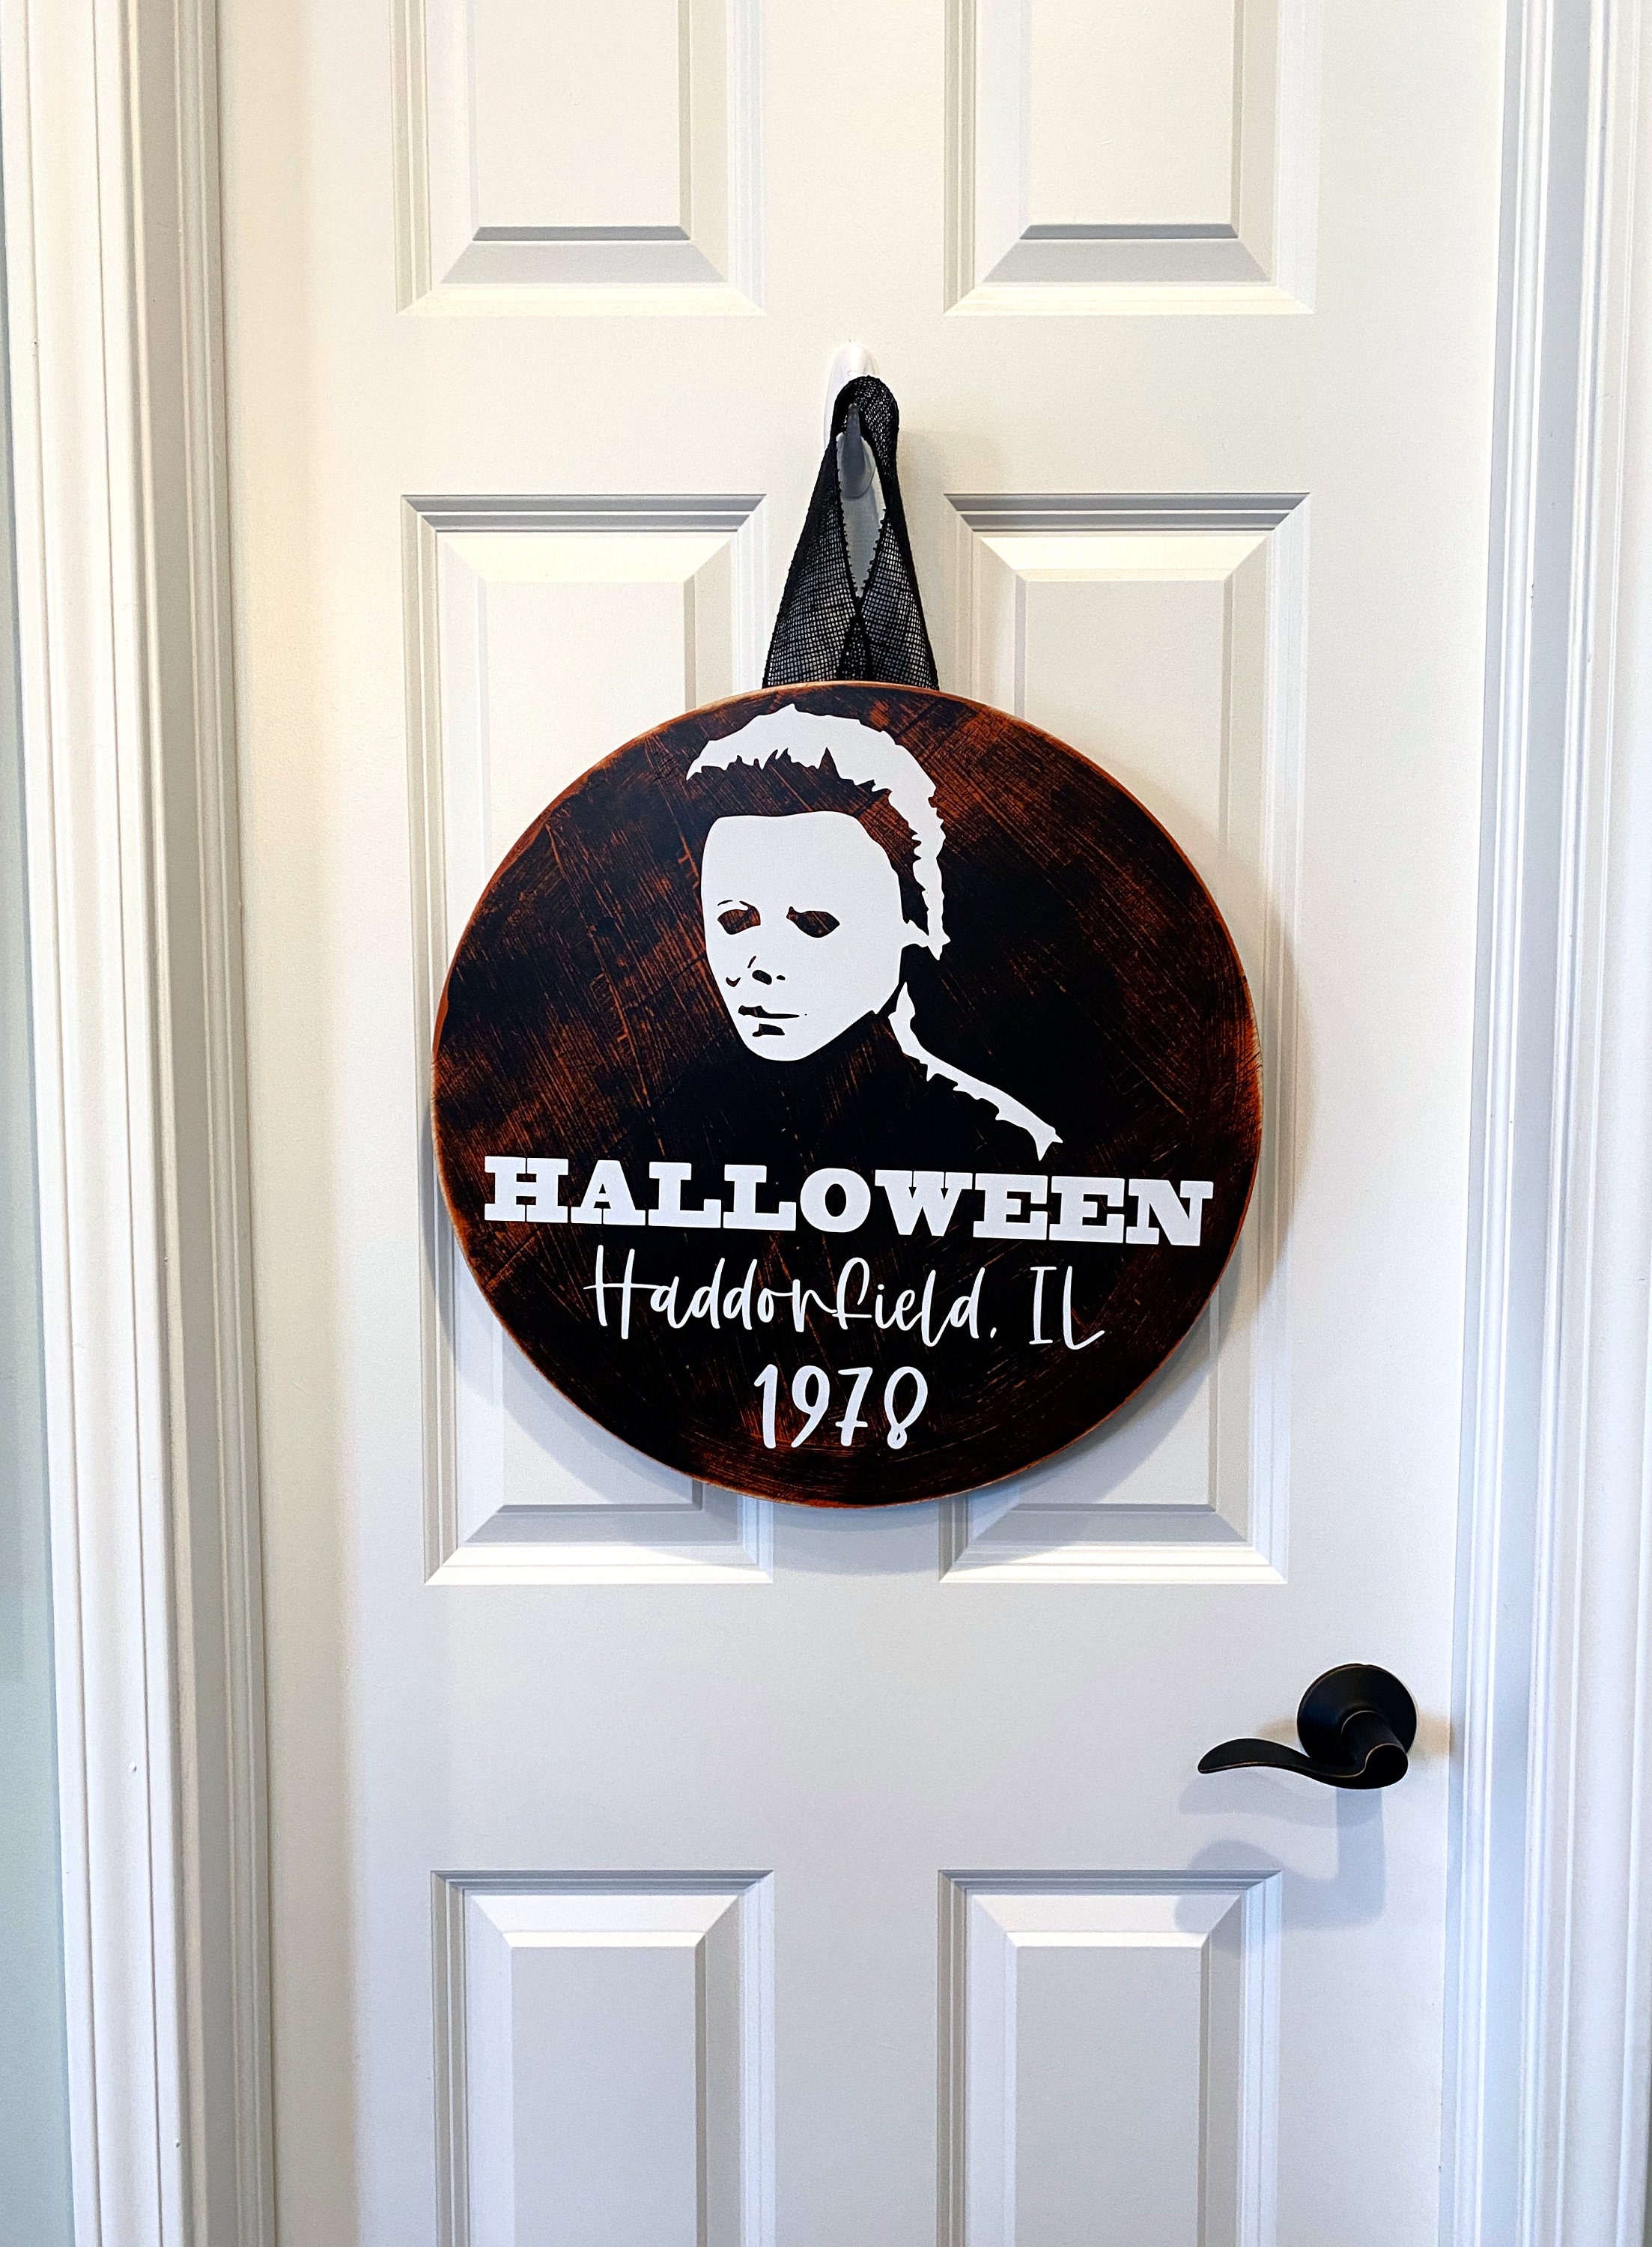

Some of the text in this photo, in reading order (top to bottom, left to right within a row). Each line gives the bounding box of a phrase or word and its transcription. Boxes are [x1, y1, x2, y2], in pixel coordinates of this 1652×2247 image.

[484, 1156, 1214, 1247] HALLOWEEN
[1028, 1265, 1106, 1350] IL
[753, 1363, 929, 1449] 1978
